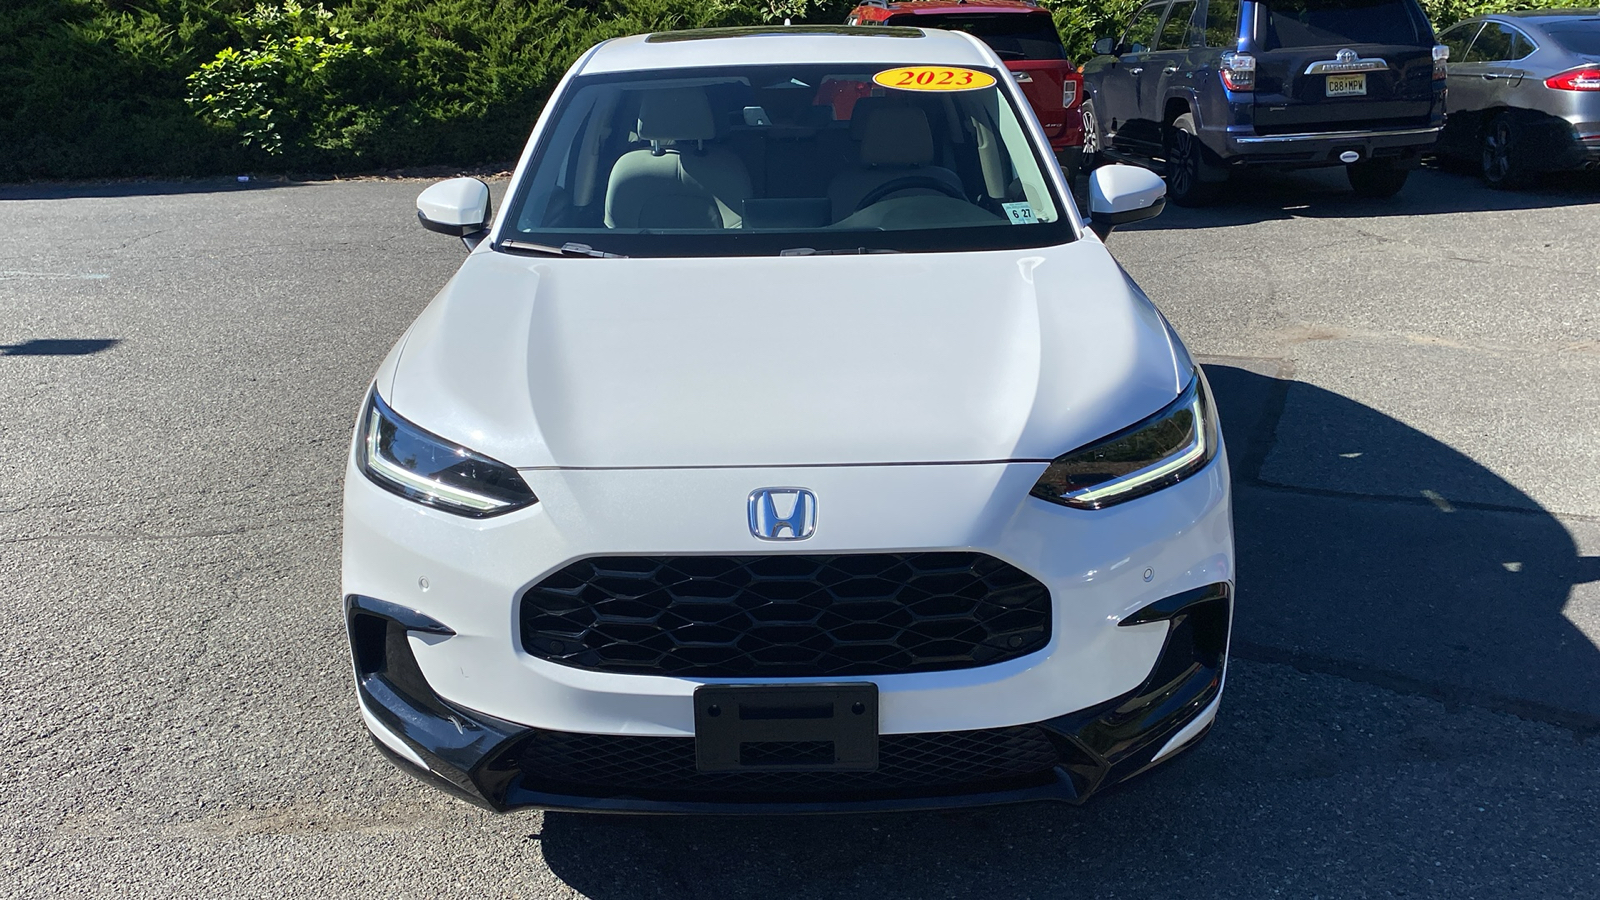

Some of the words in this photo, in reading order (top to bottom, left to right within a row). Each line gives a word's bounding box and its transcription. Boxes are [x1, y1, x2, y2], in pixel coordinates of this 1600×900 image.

[895, 71, 974, 86] 2023
[1012, 209, 1020, 219] 6
[1021, 208, 1032, 218] 27
